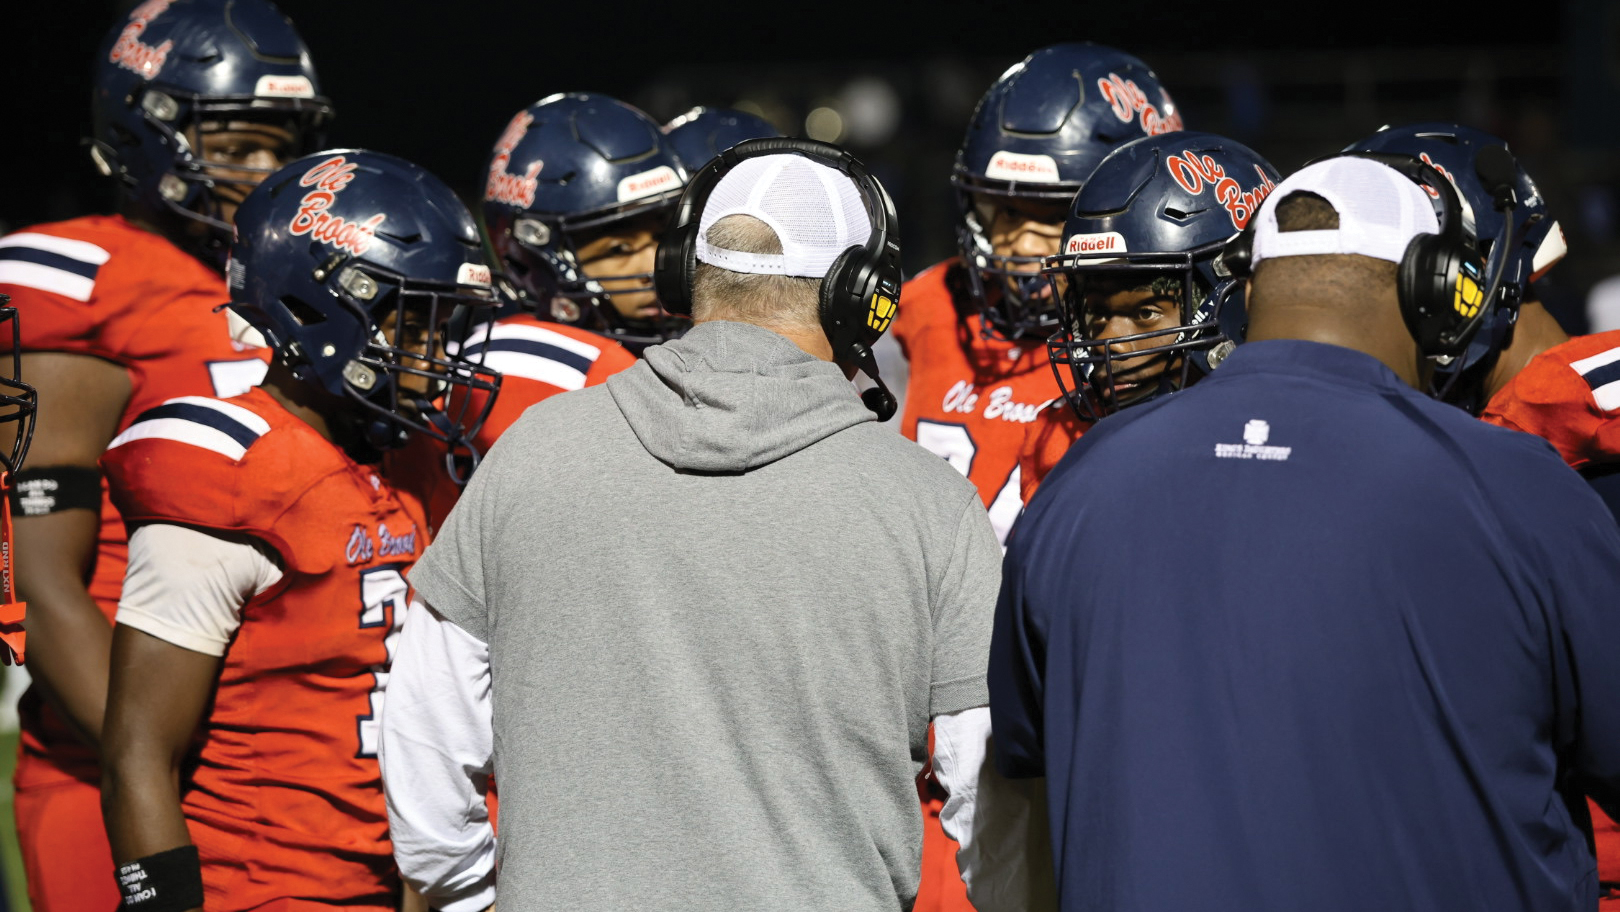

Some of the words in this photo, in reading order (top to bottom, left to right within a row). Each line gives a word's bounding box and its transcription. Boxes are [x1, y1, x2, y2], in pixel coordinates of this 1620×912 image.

[299, 155, 358, 192] Ole
[1166, 150, 1225, 195] Ole
[289, 190, 386, 257] Brook
[942, 380, 979, 414] Ole
[345, 525, 374, 564] Ole
